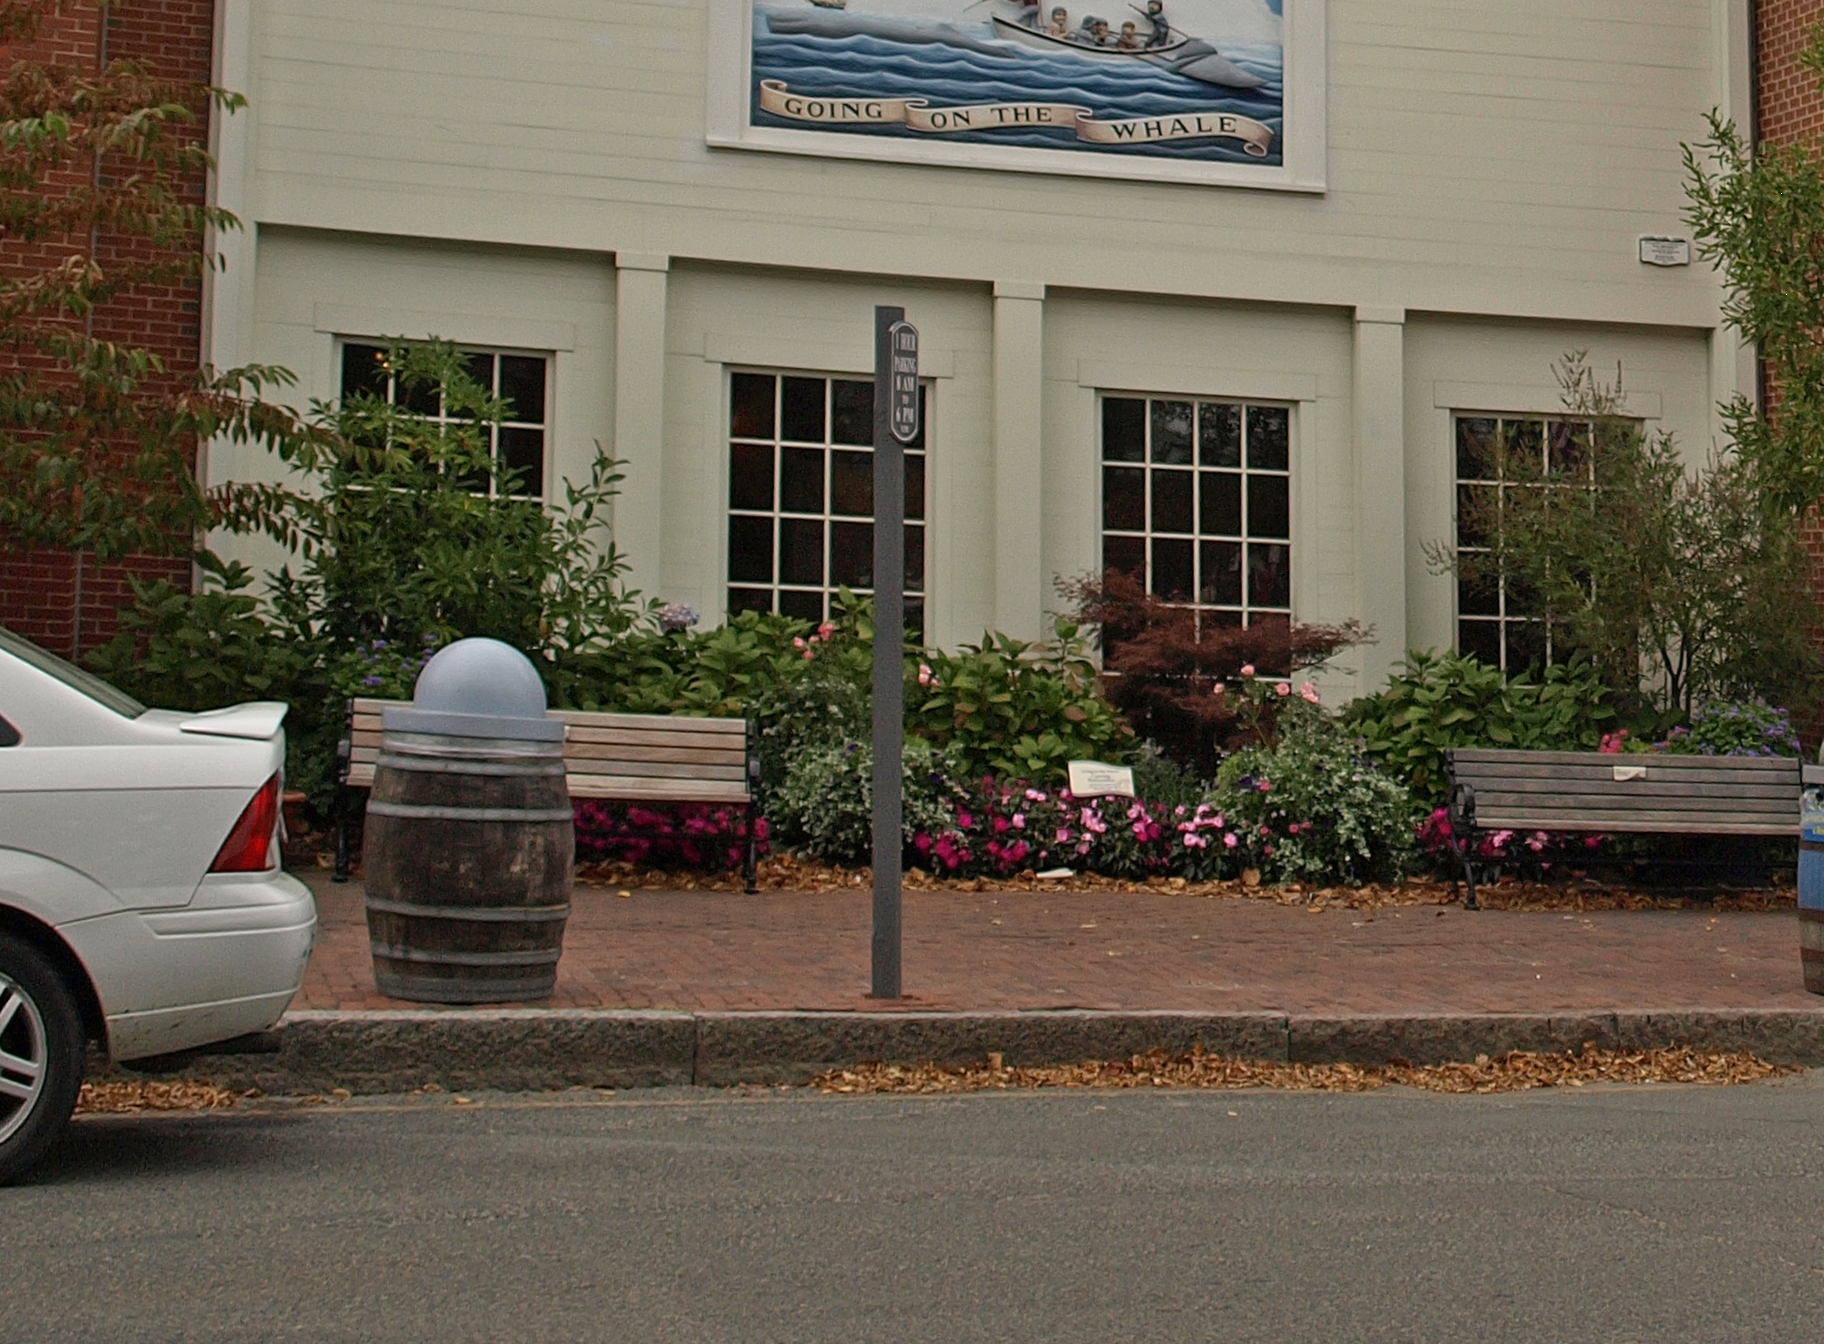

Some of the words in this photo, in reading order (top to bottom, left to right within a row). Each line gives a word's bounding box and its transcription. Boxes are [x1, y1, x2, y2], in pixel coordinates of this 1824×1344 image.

[784, 97, 884, 119] GOING
[929, 110, 972, 129] ON
[990, 106, 1053, 124] THE
[1112, 116, 1238, 141] WHALE
[903, 376, 914, 392] AM
[896, 407, 901, 422] 6
[902, 408, 914, 423] PM
